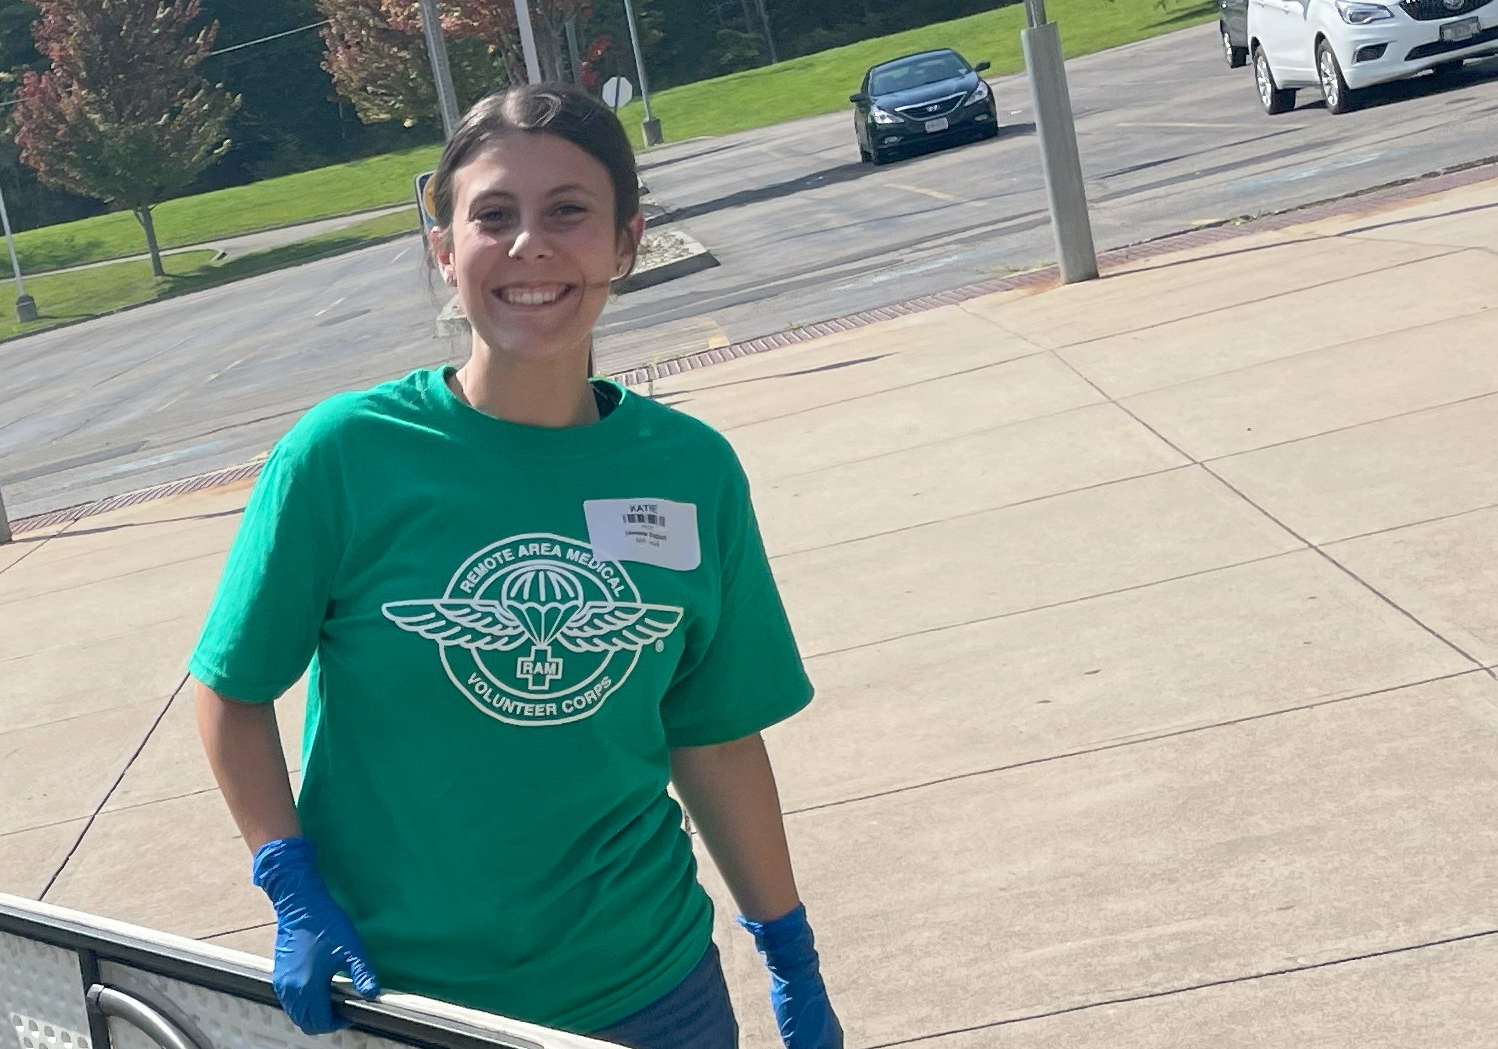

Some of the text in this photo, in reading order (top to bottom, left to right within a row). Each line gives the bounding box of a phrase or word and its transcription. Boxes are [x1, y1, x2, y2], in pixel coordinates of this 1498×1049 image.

[629, 504, 658, 514] KATIE
[459, 542, 626, 598] REMOTE AREA MEDICAL
[521, 661, 558, 675] RAM
[467, 672, 612, 717] VOLUNTEER CORPS
